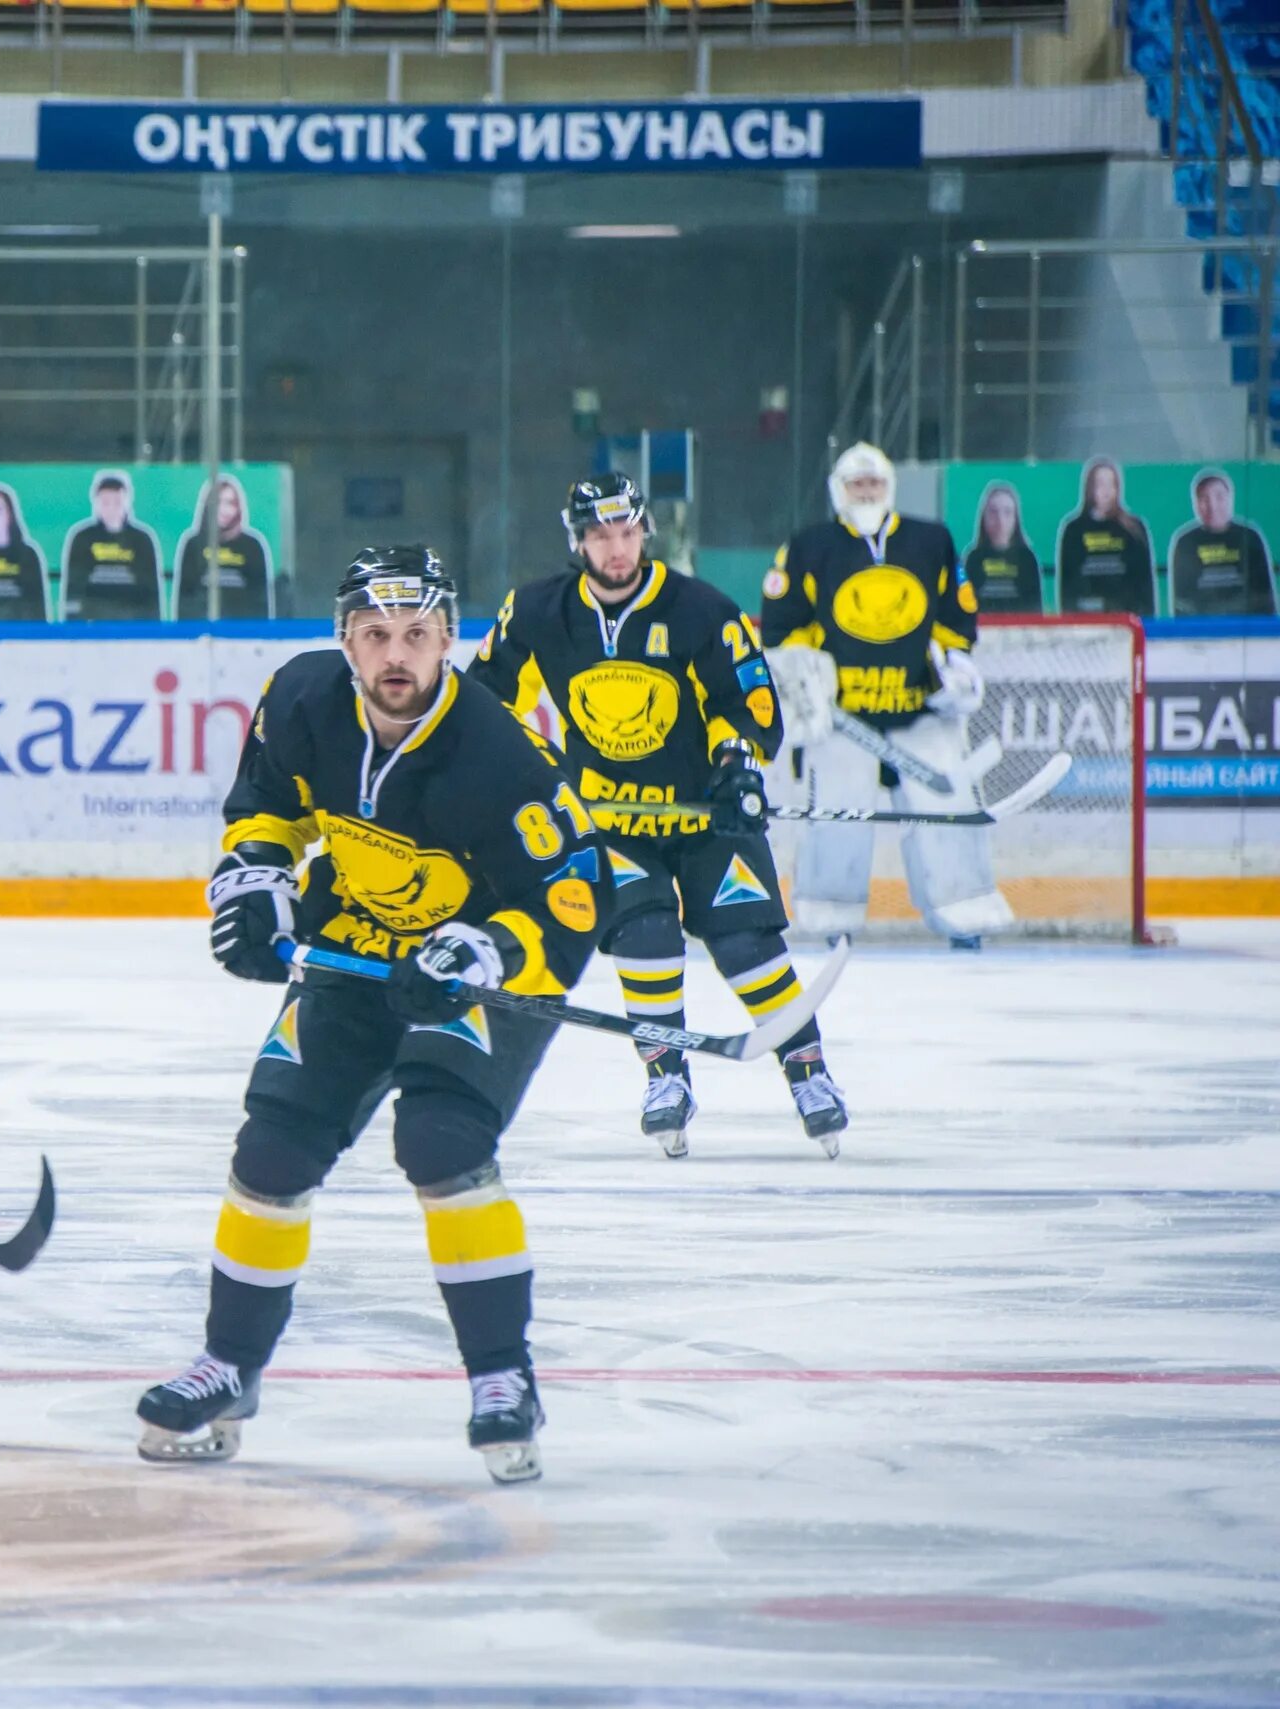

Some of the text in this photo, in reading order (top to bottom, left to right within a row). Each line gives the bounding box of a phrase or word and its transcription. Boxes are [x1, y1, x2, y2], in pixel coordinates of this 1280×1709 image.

[133, 110, 824, 171] ОҢТҮСТІК ТРИБУНАСЫ
[645, 622, 670, 658] A
[1219, 763, 1278, 788] САЙТ
[83, 796, 218, 817] Internation
[513, 781, 597, 861] 81
[210, 869, 301, 901] CCM
